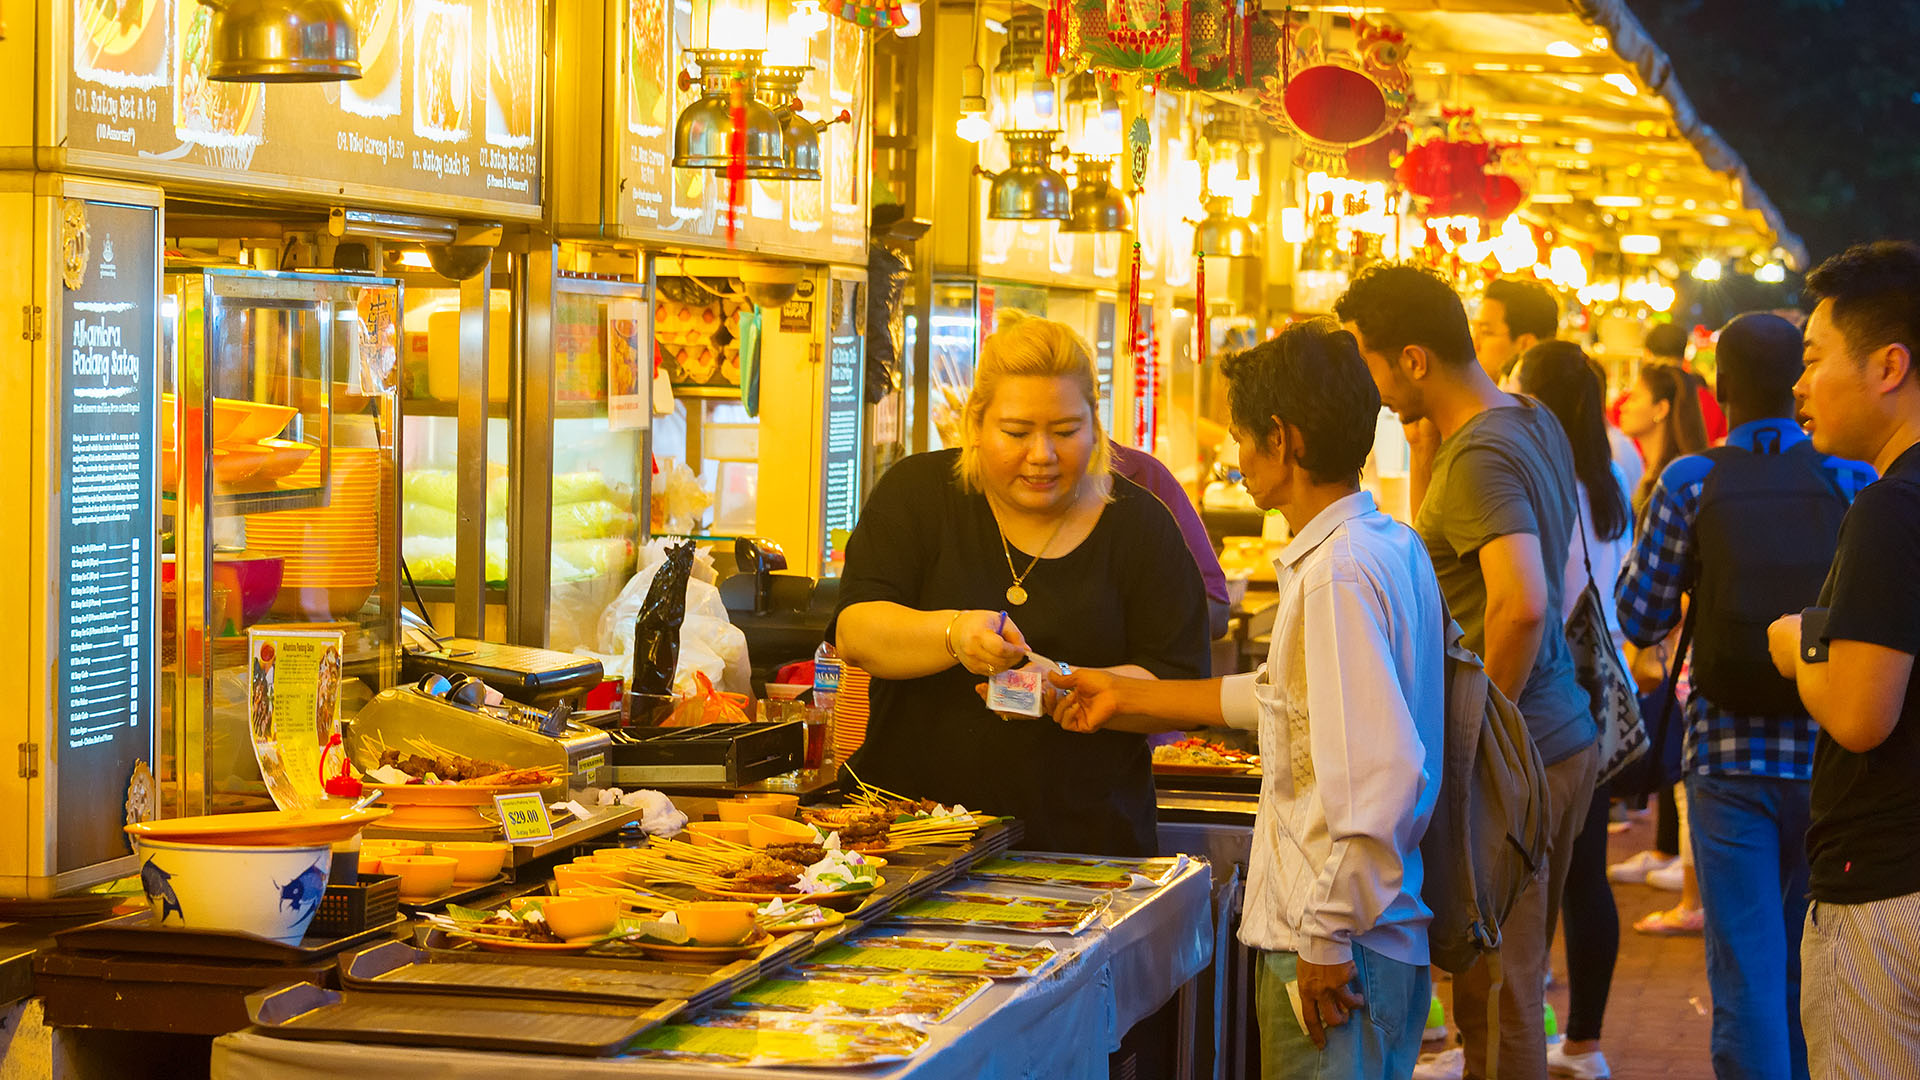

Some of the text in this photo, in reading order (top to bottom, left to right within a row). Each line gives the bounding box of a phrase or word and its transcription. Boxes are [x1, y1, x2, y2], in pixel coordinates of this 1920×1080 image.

[75, 88, 157, 124] 01. Satay Set A $9
[364, 136, 387, 165] Goreng
[423, 149, 442, 179] Satay
[443, 151, 460, 175] Gado
[490, 148, 508, 176] Satay
[508, 151, 519, 173] Set
[73, 316, 121, 347] Alhambra
[72, 347, 139, 386] Padang Satay
[508, 809, 539, 826] $29.00
